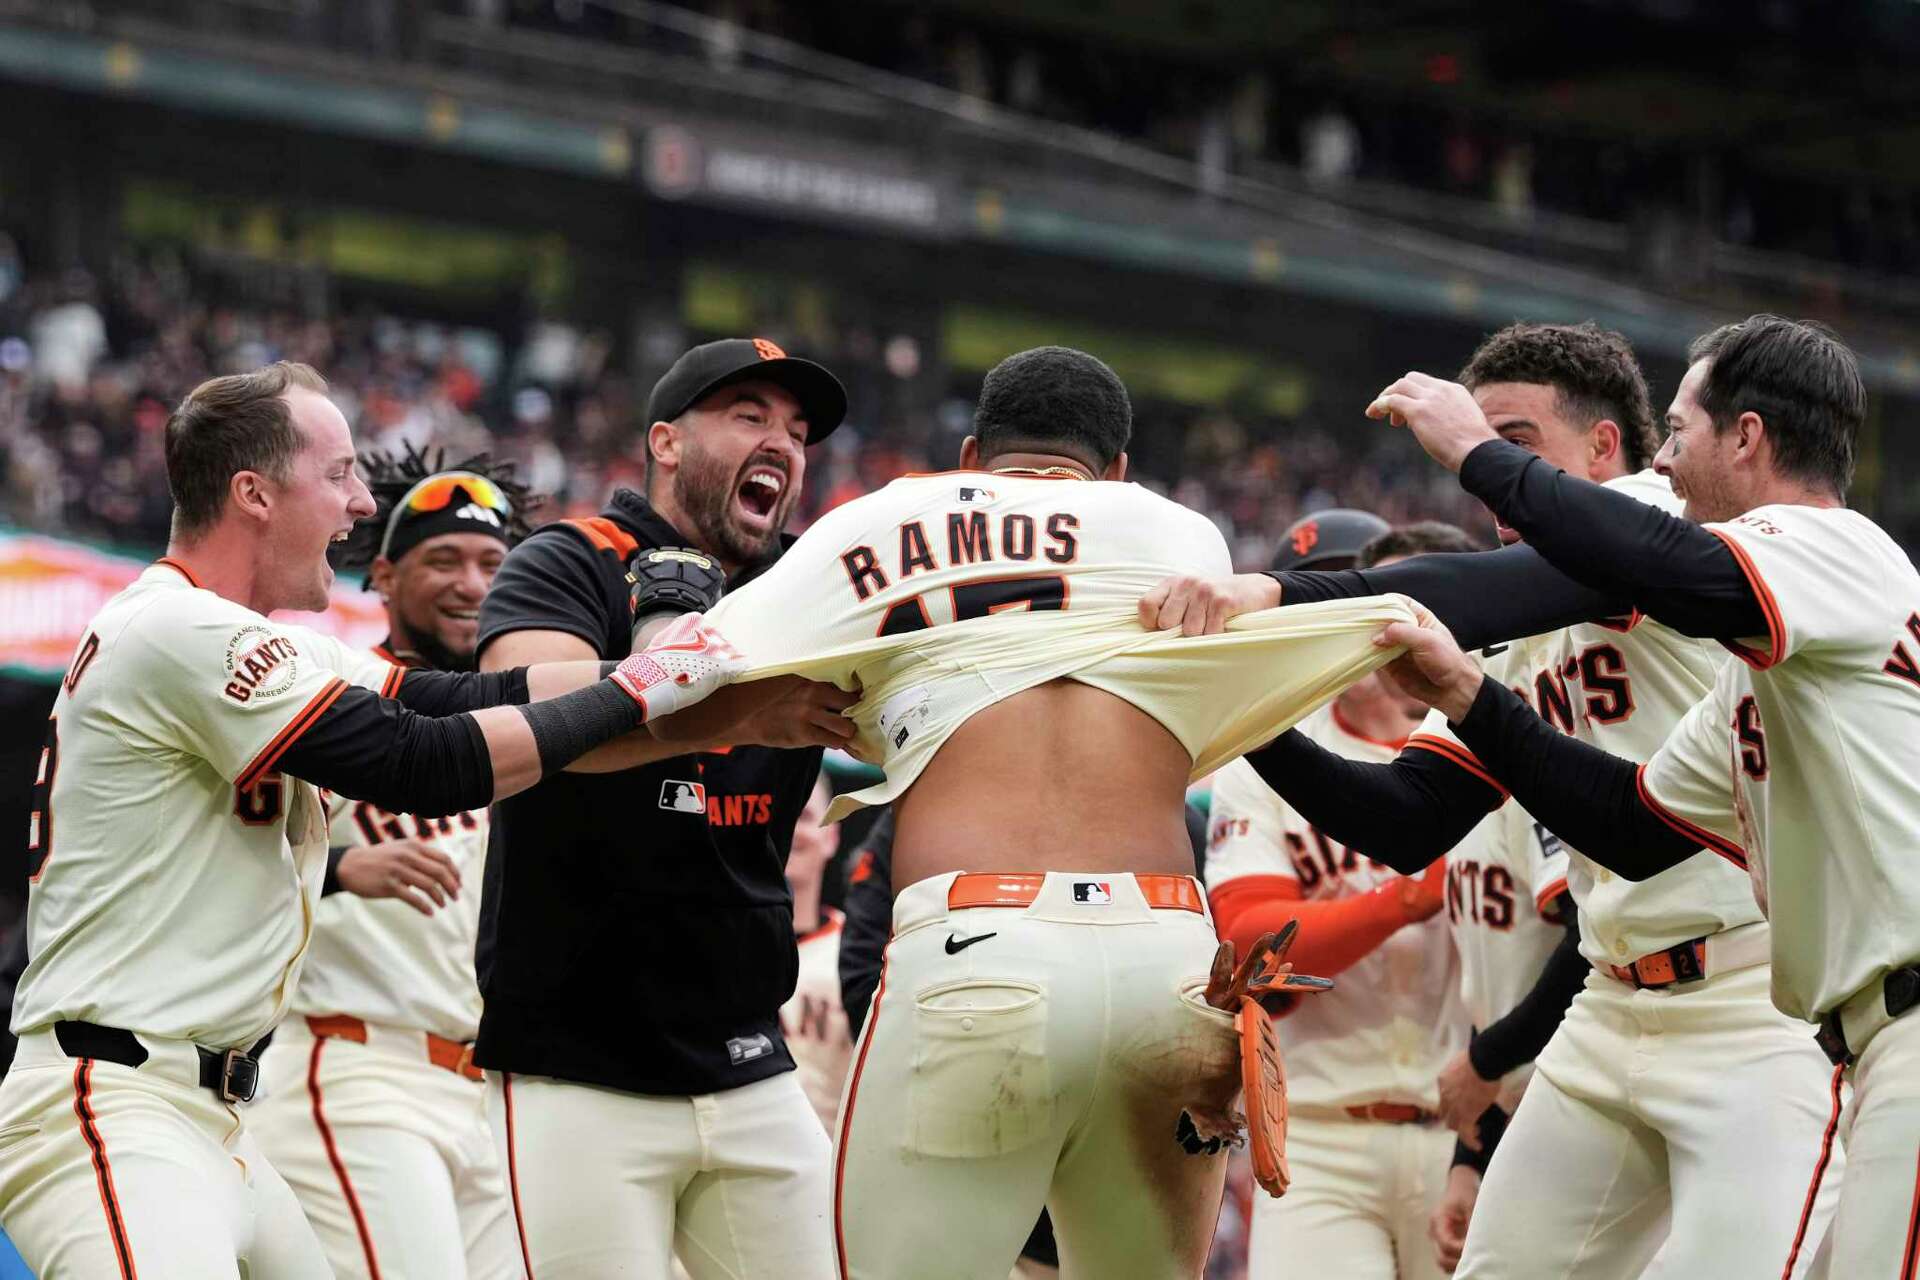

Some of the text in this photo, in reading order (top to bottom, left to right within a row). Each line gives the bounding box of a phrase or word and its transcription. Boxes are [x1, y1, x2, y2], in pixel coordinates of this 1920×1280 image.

[840, 510, 1081, 603] RAMOS
[225, 637, 298, 702] GIANTS
[226, 625, 273, 671] SAN FRANCISCO
[707, 793, 773, 827] ANTS
